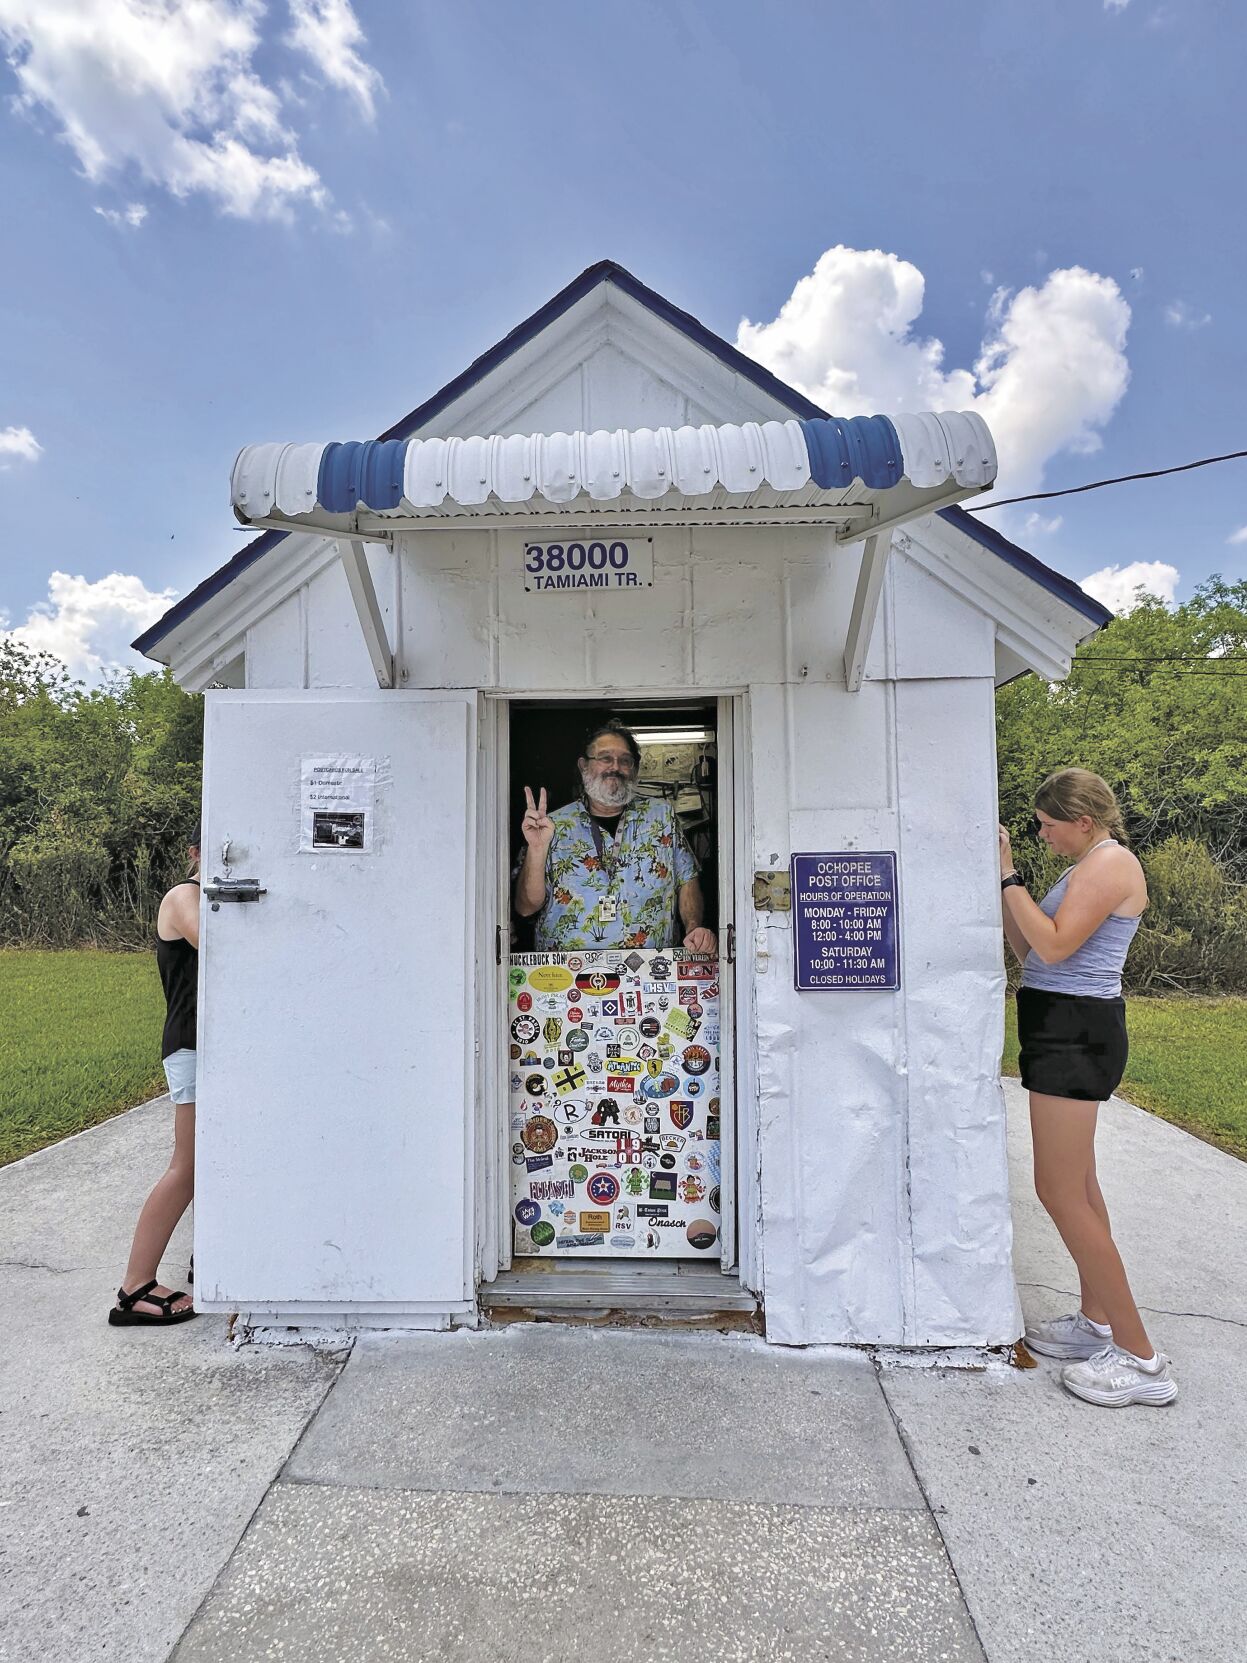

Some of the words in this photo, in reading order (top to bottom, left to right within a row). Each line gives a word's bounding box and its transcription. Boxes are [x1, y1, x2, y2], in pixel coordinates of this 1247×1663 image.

[526, 542, 629, 573] 38000
[534, 573, 609, 590] TAMIAMI
[614, 572, 643, 587] TR.
[817, 862, 872, 874] OCHOPEE
[809, 875, 838, 887] POST
[841, 875, 881, 887] OFFICE
[800, 892, 829, 901] HOURS
[830, 892, 843, 900] OF
[844, 891, 892, 900] OPERATION
[804, 907, 846, 918] MONDAY
[853, 906, 888, 917] FRIDAY
[811, 919, 831, 930] 8:00
[839, 919, 864, 929] 10:00
[866, 919, 882, 929] AM
[812, 931, 837, 941] 12:00
[844, 931, 865, 941] 4:00
[867, 931, 882, 941] PM
[821, 947, 873, 957] SATURDAY
[509, 953, 550, 967] HUCKLEBUCK
[809, 959, 835, 969] 10:00
[843, 959, 868, 969] 11:30
[870, 959, 885, 969] AM
[809, 975, 843, 984] CLOSED
[845, 975, 886, 984] HOLIDAYS
[650, 984, 670, 993] HSV
[607, 1060, 641, 1072] ATLANTIC
[563, 1103, 579, 1121] R
[589, 1130, 631, 1139] SATORI
[584, 1154, 608, 1162] HOLE
[615, 1222, 632, 1230] RSV
[648, 1216, 687, 1228] Onasch
[1110, 1373, 1142, 1389] HOKA
